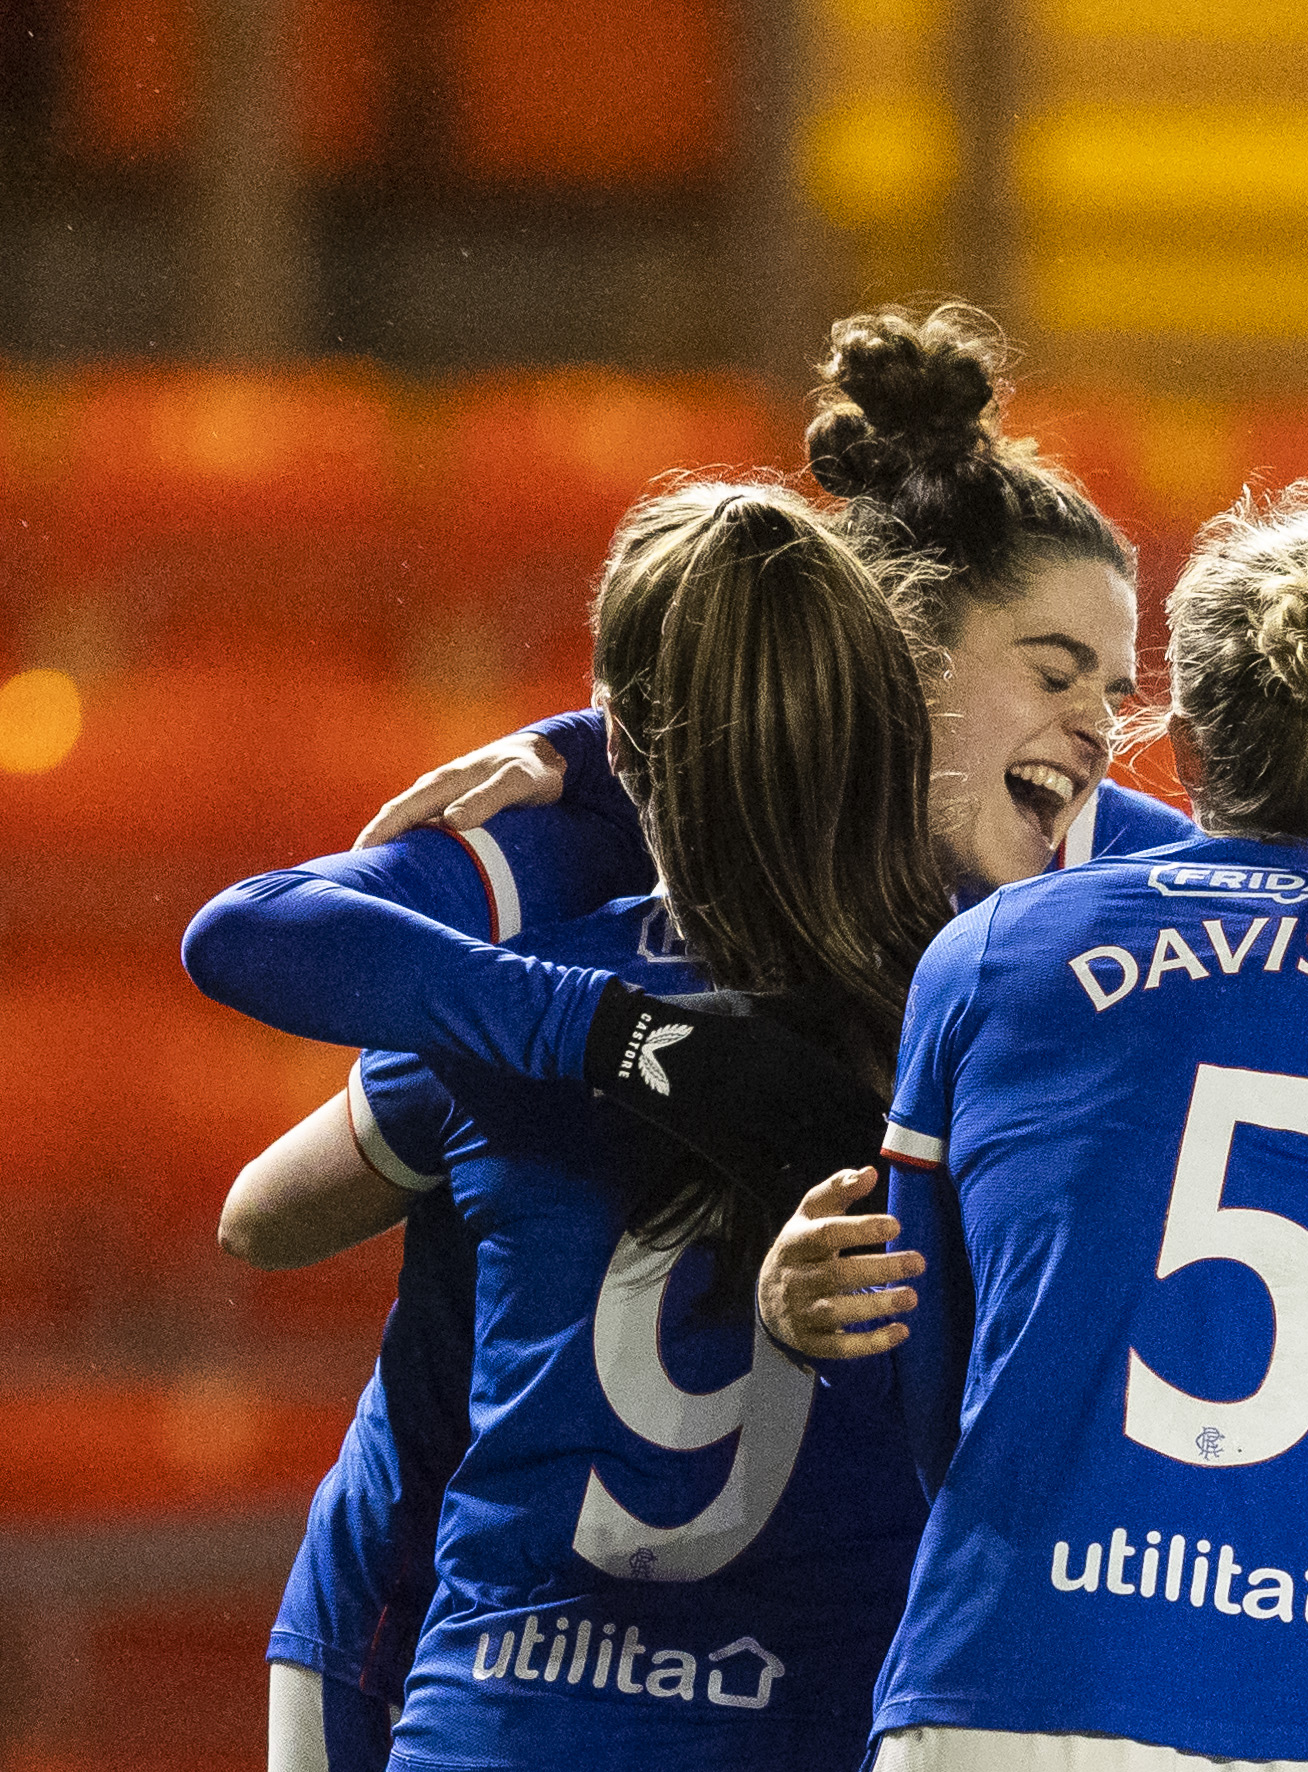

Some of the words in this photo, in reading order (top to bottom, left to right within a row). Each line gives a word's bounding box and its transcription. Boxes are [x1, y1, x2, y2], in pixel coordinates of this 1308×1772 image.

[618, 1012, 652, 1079] CASTORE
[571, 1190, 818, 1583] 9
[1051, 1527, 1294, 1624] utilita
[472, 1614, 697, 1701] utilita
